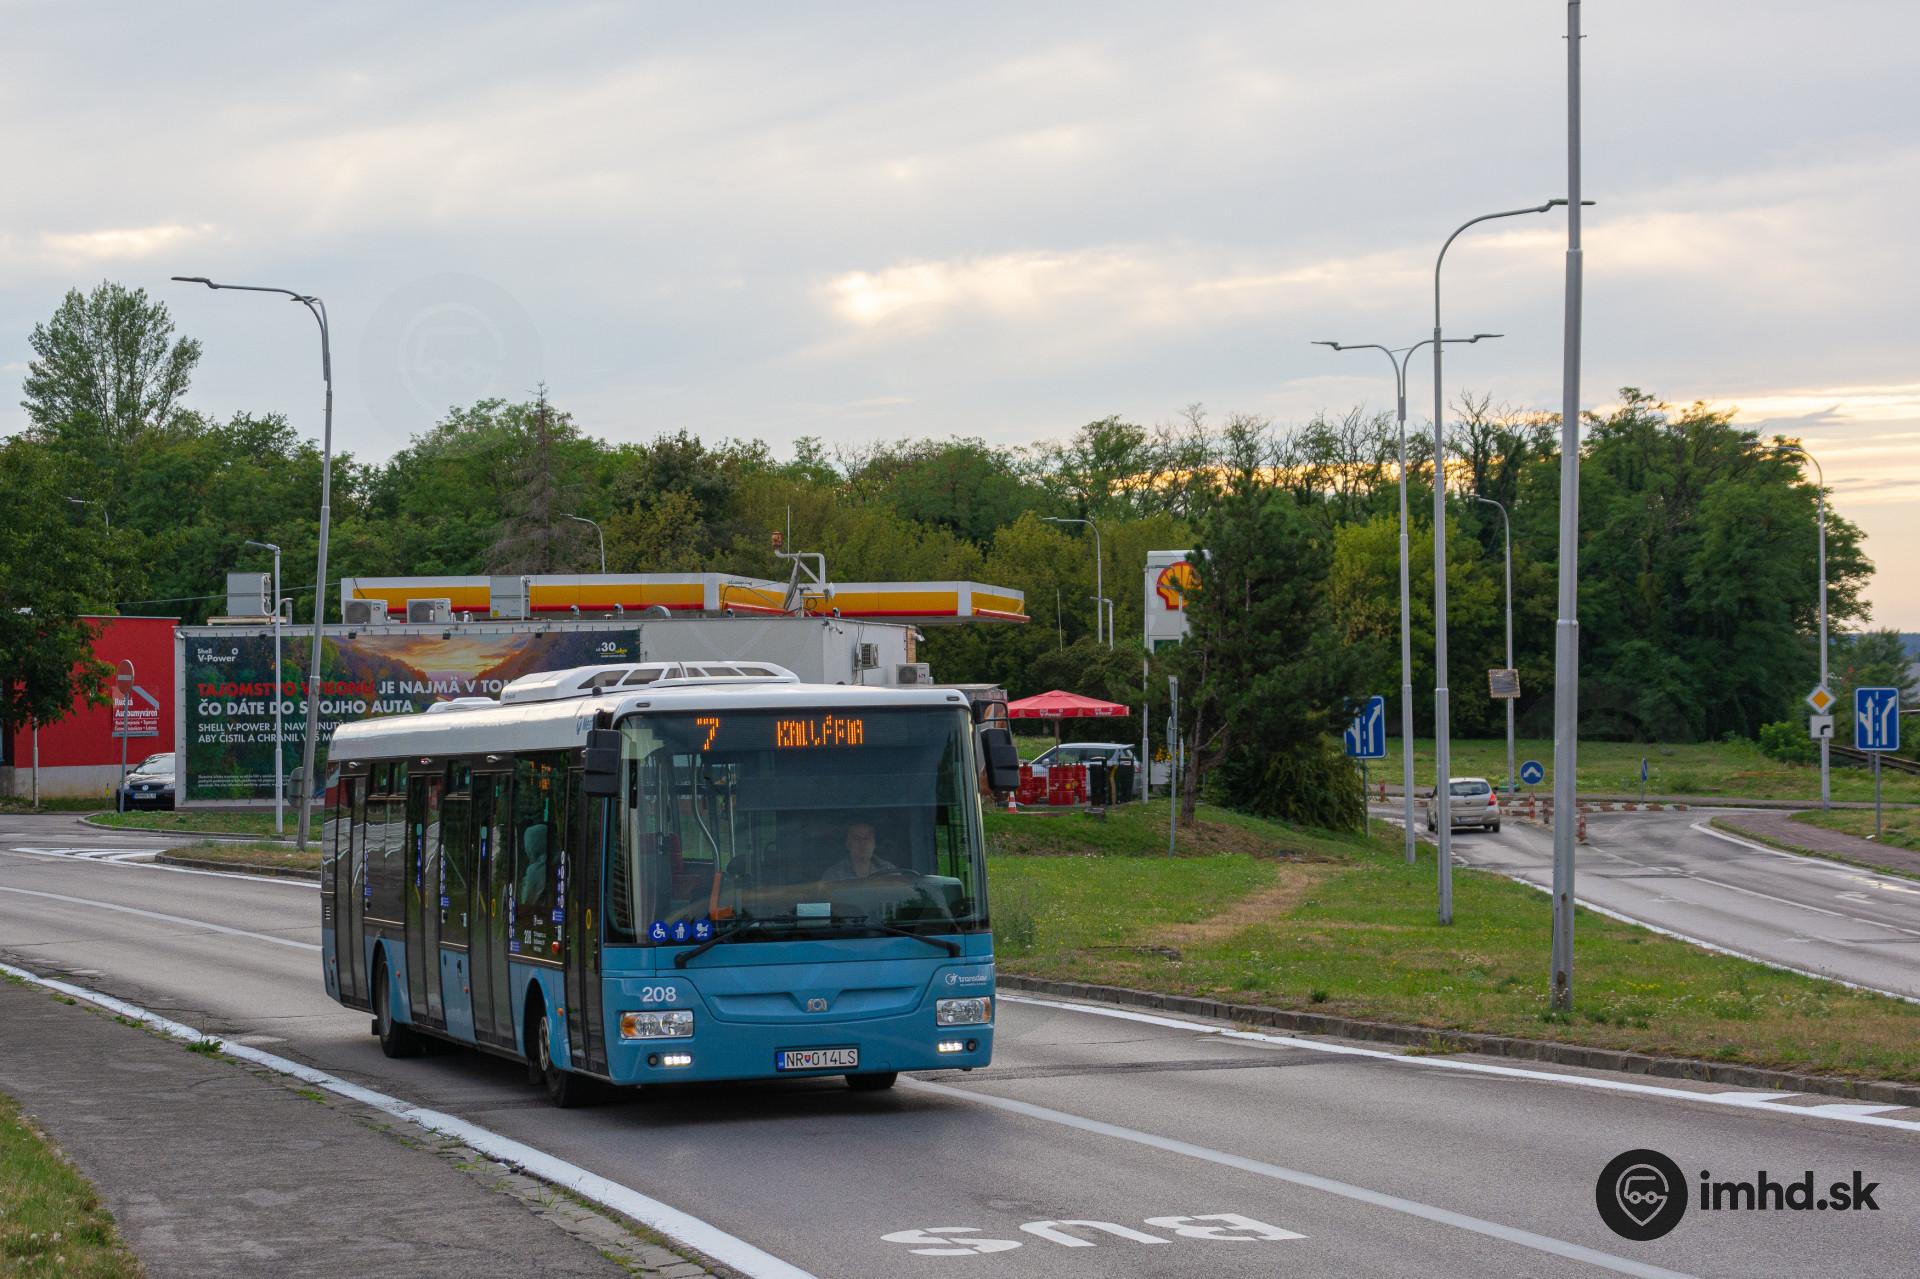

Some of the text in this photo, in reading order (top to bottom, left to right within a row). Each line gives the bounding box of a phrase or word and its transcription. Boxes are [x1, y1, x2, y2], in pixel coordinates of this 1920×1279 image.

[197, 654, 236, 662] V-Power
[378, 681, 395, 694] JE
[400, 676, 460, 694] NAJMÄ
[464, 680, 477, 693] V
[198, 698, 222, 716] ČO
[226, 698, 265, 715] DÁTE
[299, 700, 367, 714] SOJHO
[371, 700, 414, 713] AUTA
[198, 723, 225, 732] SHELL
[227, 722, 271, 732] V-POWER
[696, 717, 719, 750] 7
[198, 734, 217, 743] ABY
[219, 731, 246, 743] ČISTIL
[247, 734, 256, 743] A
[642, 986, 676, 1002] 208
[786, 1054, 804, 1067] NR
[880, 1212, 1311, 1256] BUS
